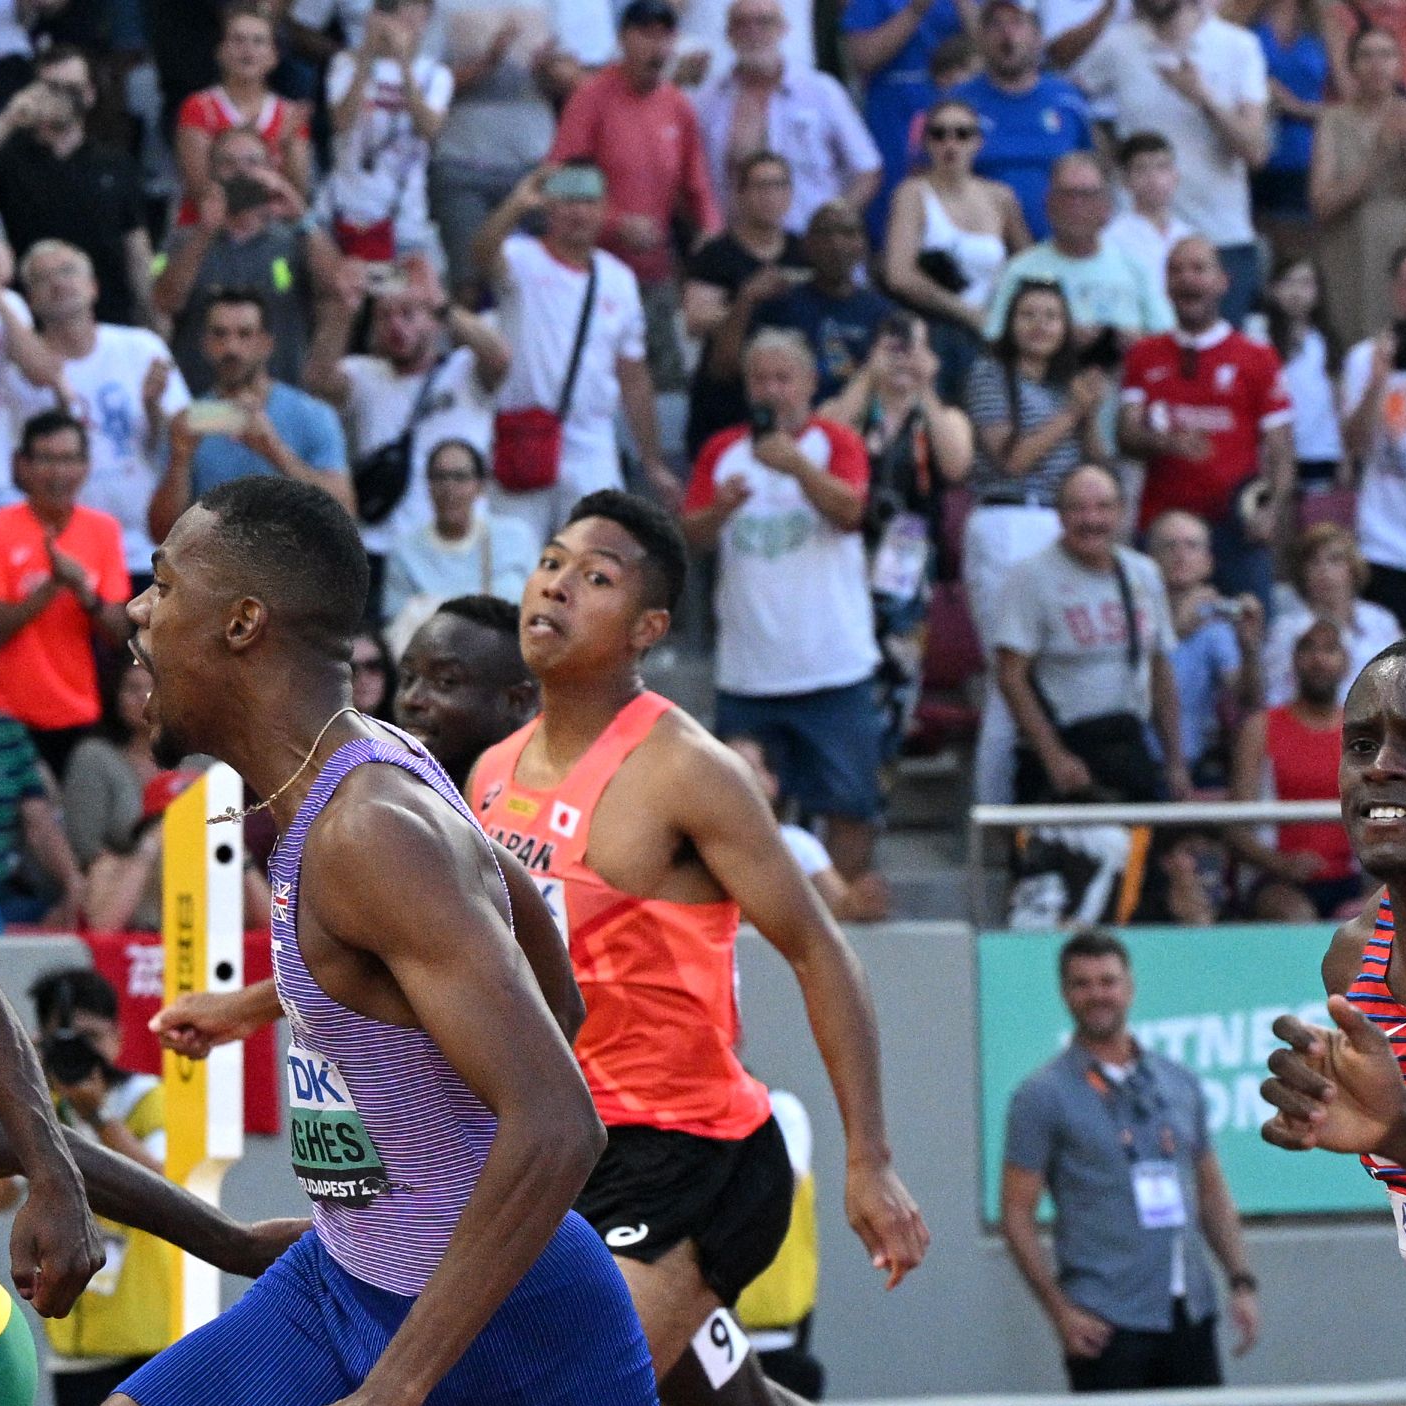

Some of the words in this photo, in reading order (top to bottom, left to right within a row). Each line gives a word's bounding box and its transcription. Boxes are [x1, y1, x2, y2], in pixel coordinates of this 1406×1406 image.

[489, 827, 557, 872] APAN
[291, 1117, 366, 1164] GHES
[709, 1316, 735, 1363] 9
